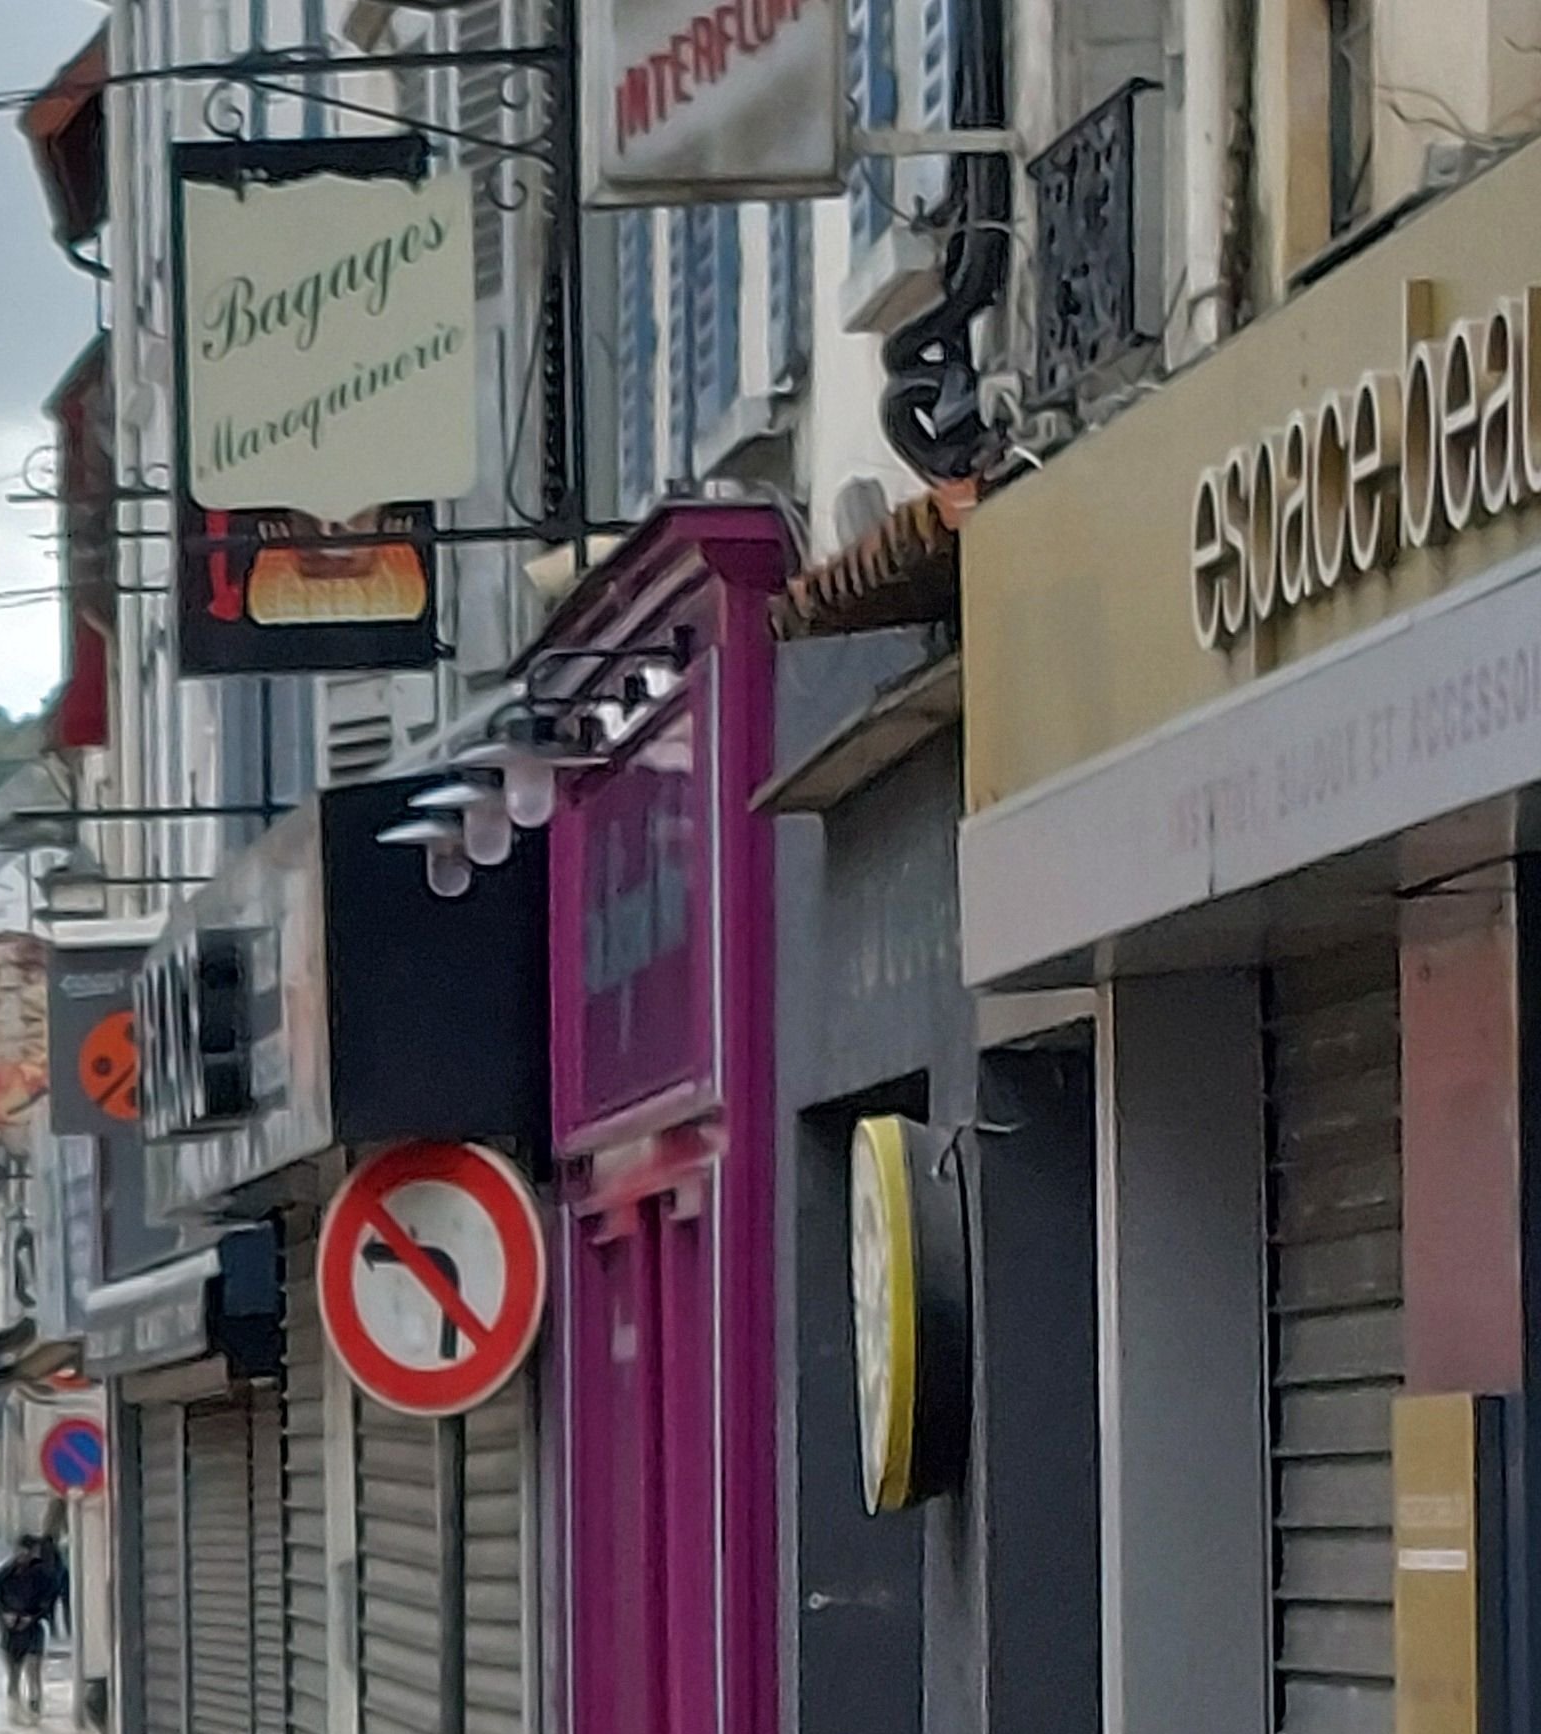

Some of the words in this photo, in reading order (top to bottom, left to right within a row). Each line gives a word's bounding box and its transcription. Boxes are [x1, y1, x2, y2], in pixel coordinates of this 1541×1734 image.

[615, 0, 800, 156] INTERFLO
[202, 213, 449, 362] Bagages
[196, 321, 464, 478] Maroquinerie
[1190, 367, 1389, 678] espace
